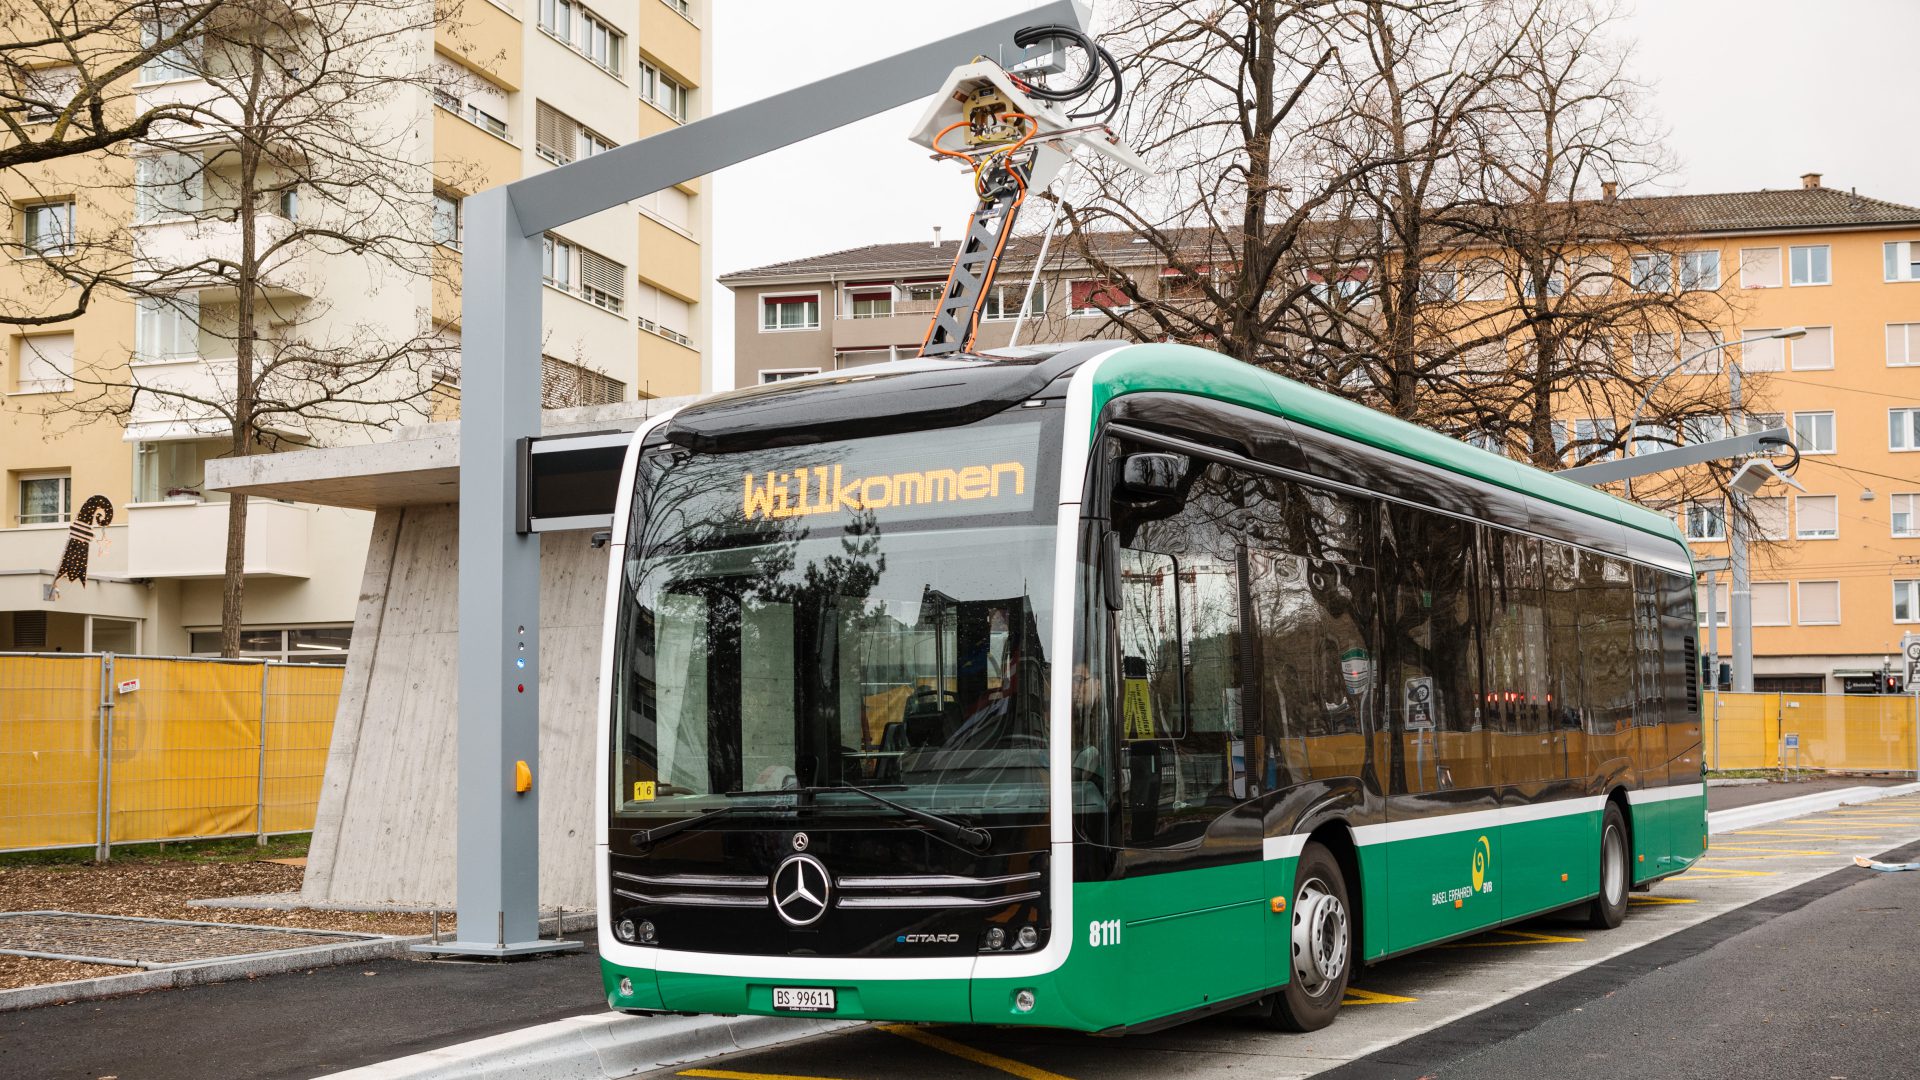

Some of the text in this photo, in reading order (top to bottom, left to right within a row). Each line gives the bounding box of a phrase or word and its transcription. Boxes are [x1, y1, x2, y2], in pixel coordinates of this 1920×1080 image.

[743, 461, 1025, 520] Willkommen
[1431, 886, 1472, 905] BASEL ERFAHREN
[1482, 881, 1493, 893] BVB
[1089, 918, 1121, 948] 8111
